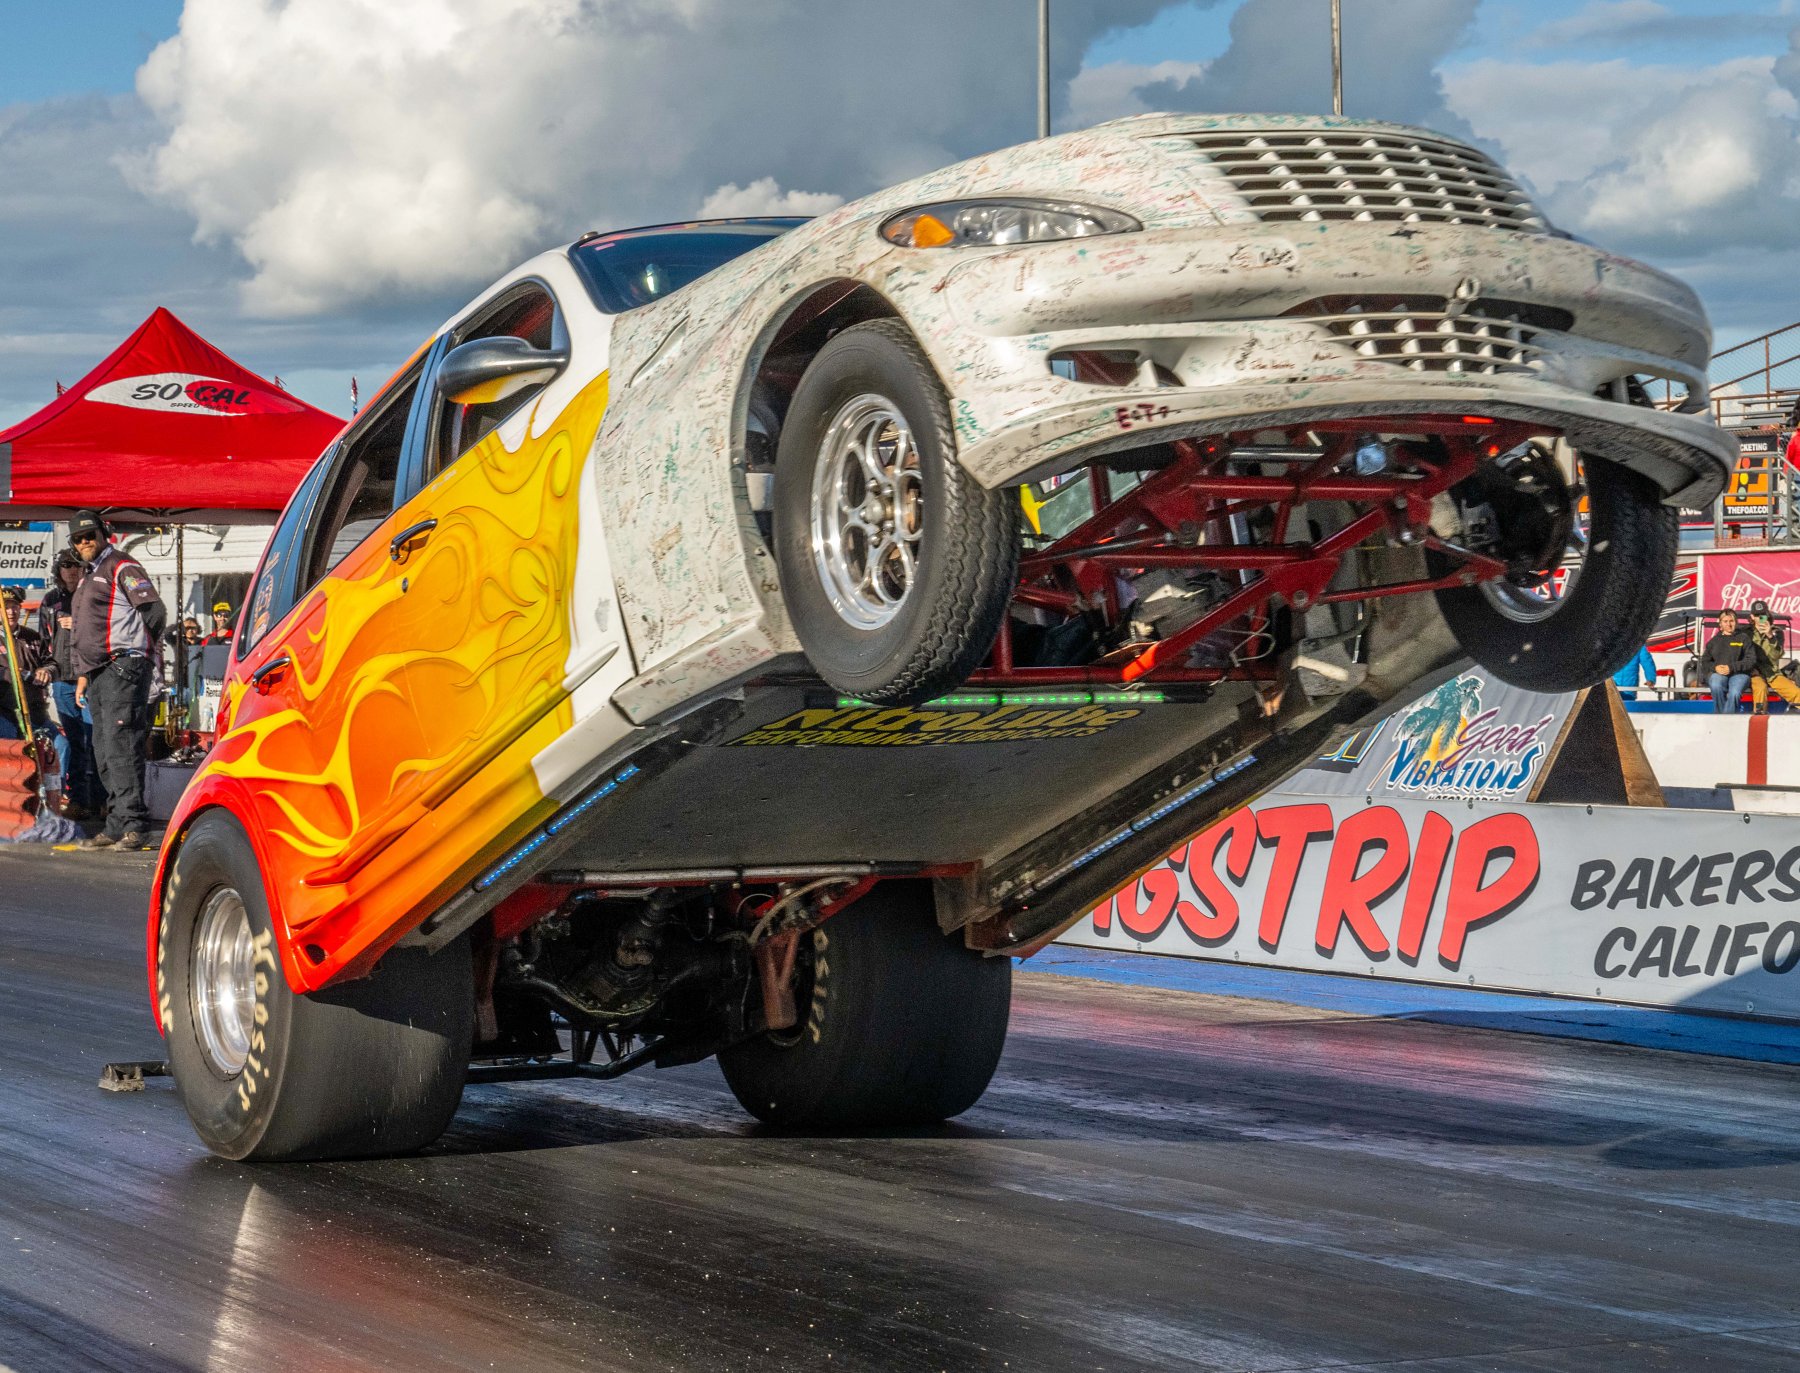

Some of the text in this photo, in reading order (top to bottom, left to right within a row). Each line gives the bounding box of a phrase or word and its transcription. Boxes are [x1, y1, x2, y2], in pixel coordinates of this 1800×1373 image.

[131, 383, 250, 405] SO-CAL
[0, 541, 45, 555] nited
[0, 556, 49, 569] entals
[724, 726, 1108, 746] PERFORMANCE LUBRICANTS
[1441, 707, 1554, 771] Good
[1386, 738, 1545, 795] VIBRATIONS
[1093, 802, 1540, 971] GSTRIP
[1570, 845, 1800, 911] BAKERS
[1594, 920, 1800, 979] CALIFO
[239, 927, 277, 1112] Hoosier
